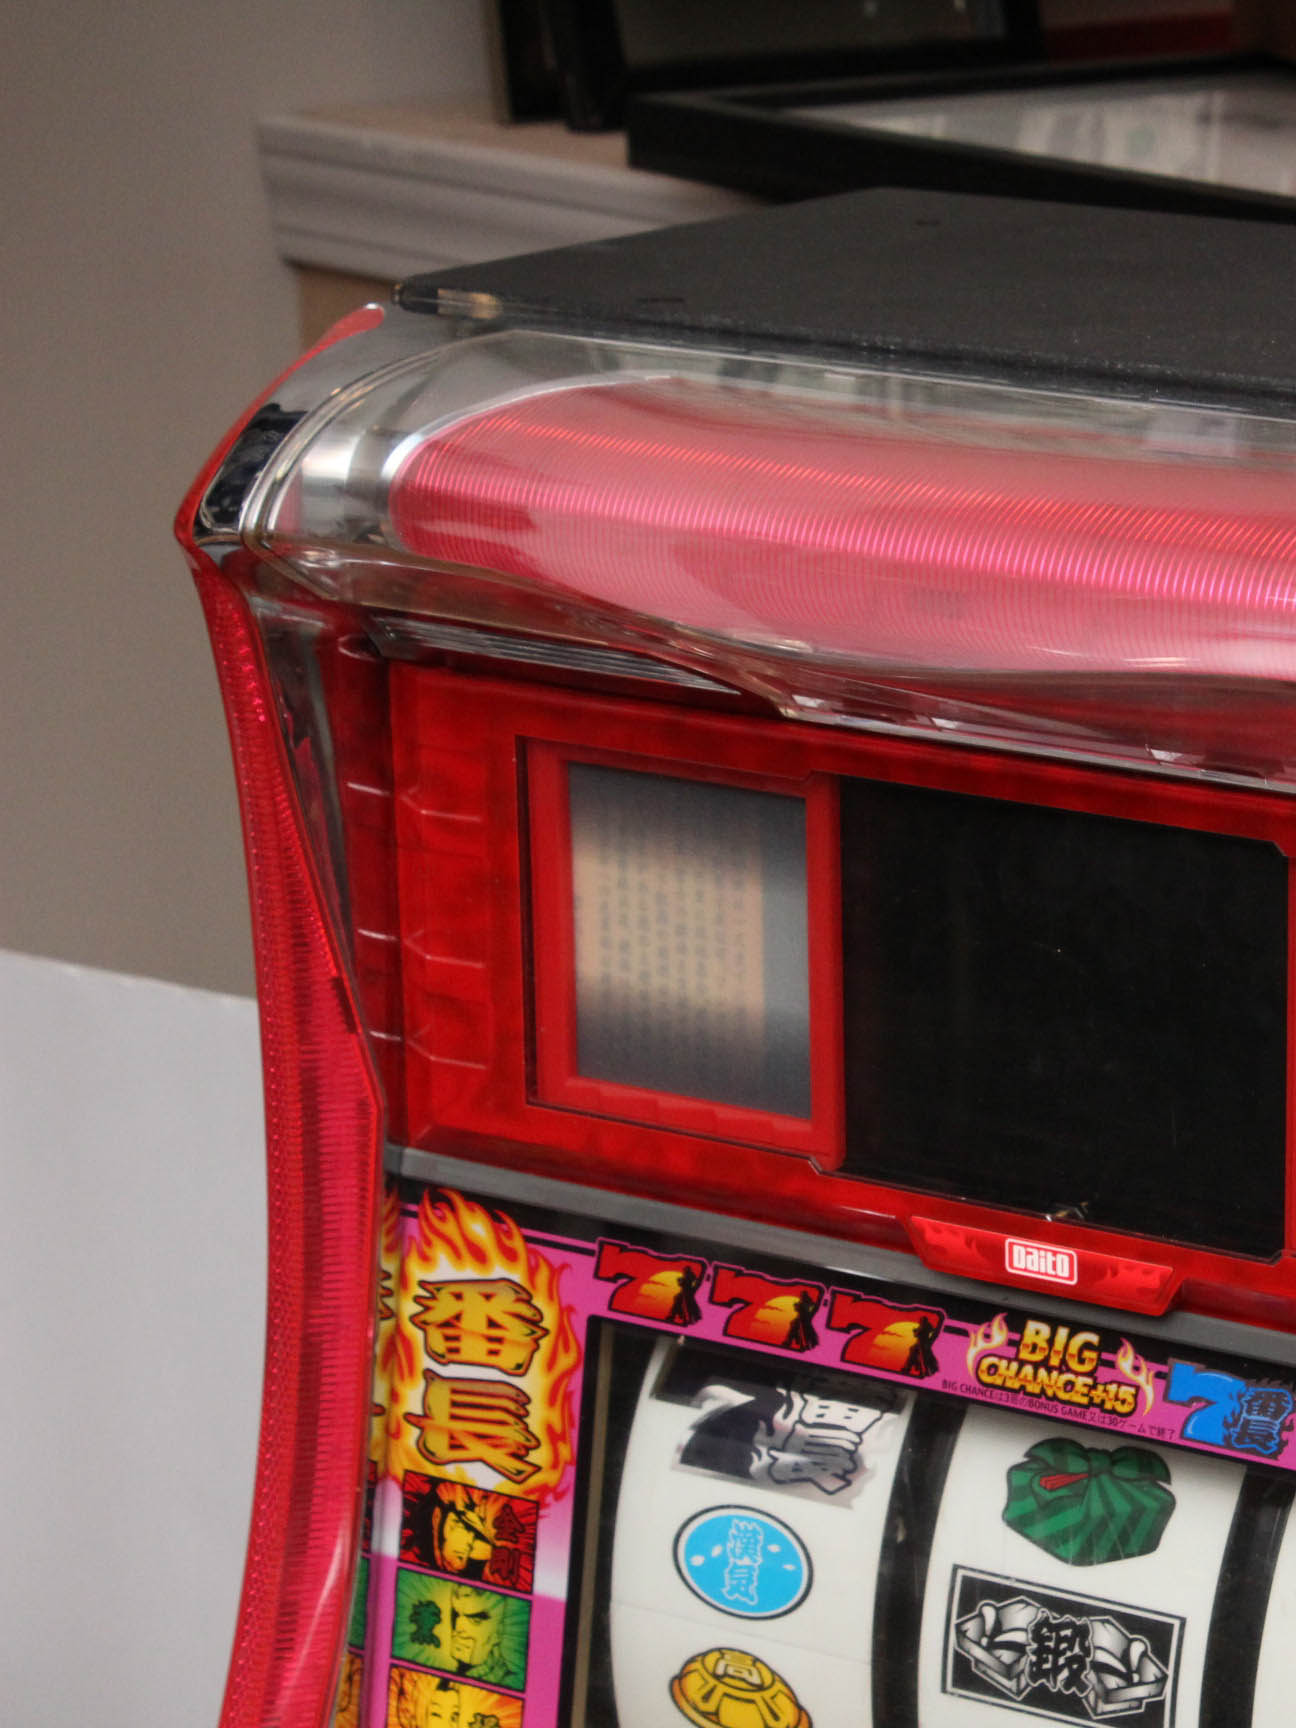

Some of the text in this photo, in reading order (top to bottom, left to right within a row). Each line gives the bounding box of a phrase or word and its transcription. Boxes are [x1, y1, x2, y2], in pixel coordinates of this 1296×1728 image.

[595, 1243, 945, 1379] 7 7 7
[1017, 1320, 1101, 1373] BIG
[403, 1278, 550, 1484] 番長
